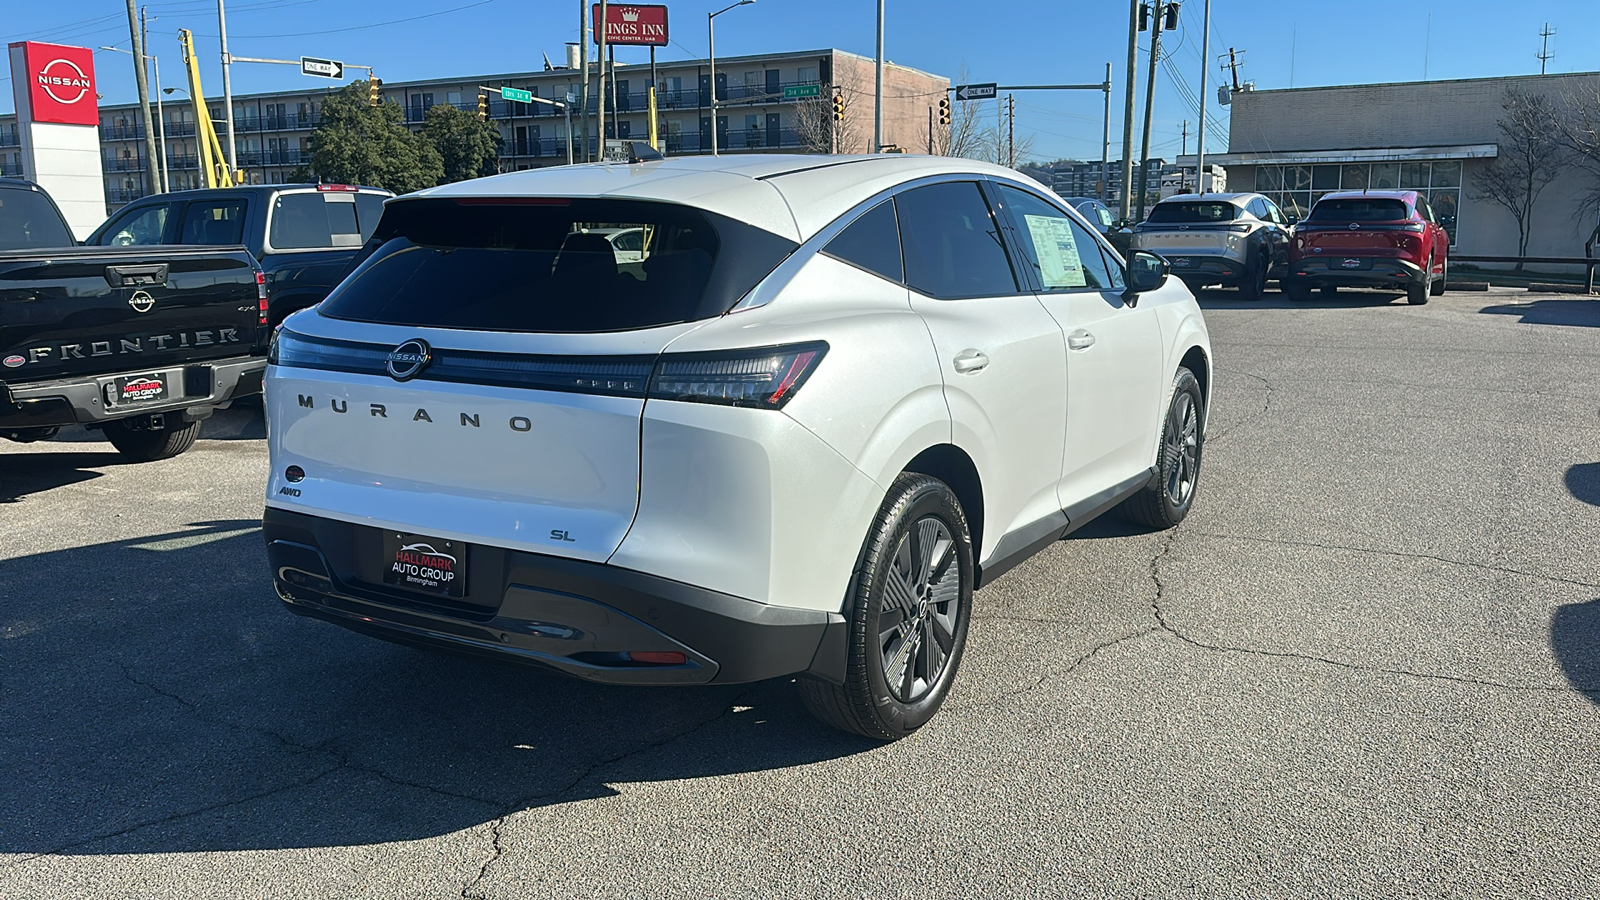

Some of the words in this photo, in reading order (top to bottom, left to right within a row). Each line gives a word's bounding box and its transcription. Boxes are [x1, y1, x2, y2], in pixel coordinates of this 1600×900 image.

[599, 23, 637, 35] INGS
[642, 24, 664, 36] INN
[306, 63, 317, 71] ONE
[38, 75, 90, 88] NISSAN
[28, 328, 240, 364] FRONTIER
[388, 353, 425, 362] NISSAN
[122, 390, 140, 398] AUTO
[141, 387, 163, 396] GROUP
[123, 382, 160, 392] HALLMARK
[298, 394, 532, 432] MURANO
[279, 486, 302, 498] AWD
[550, 529, 576, 542] SL
[395, 550, 453, 571] HALLMARK
[391, 561, 419, 576] AUTO
[420, 566, 455, 582] GROUP
[406, 575, 438, 587] Birmingham
